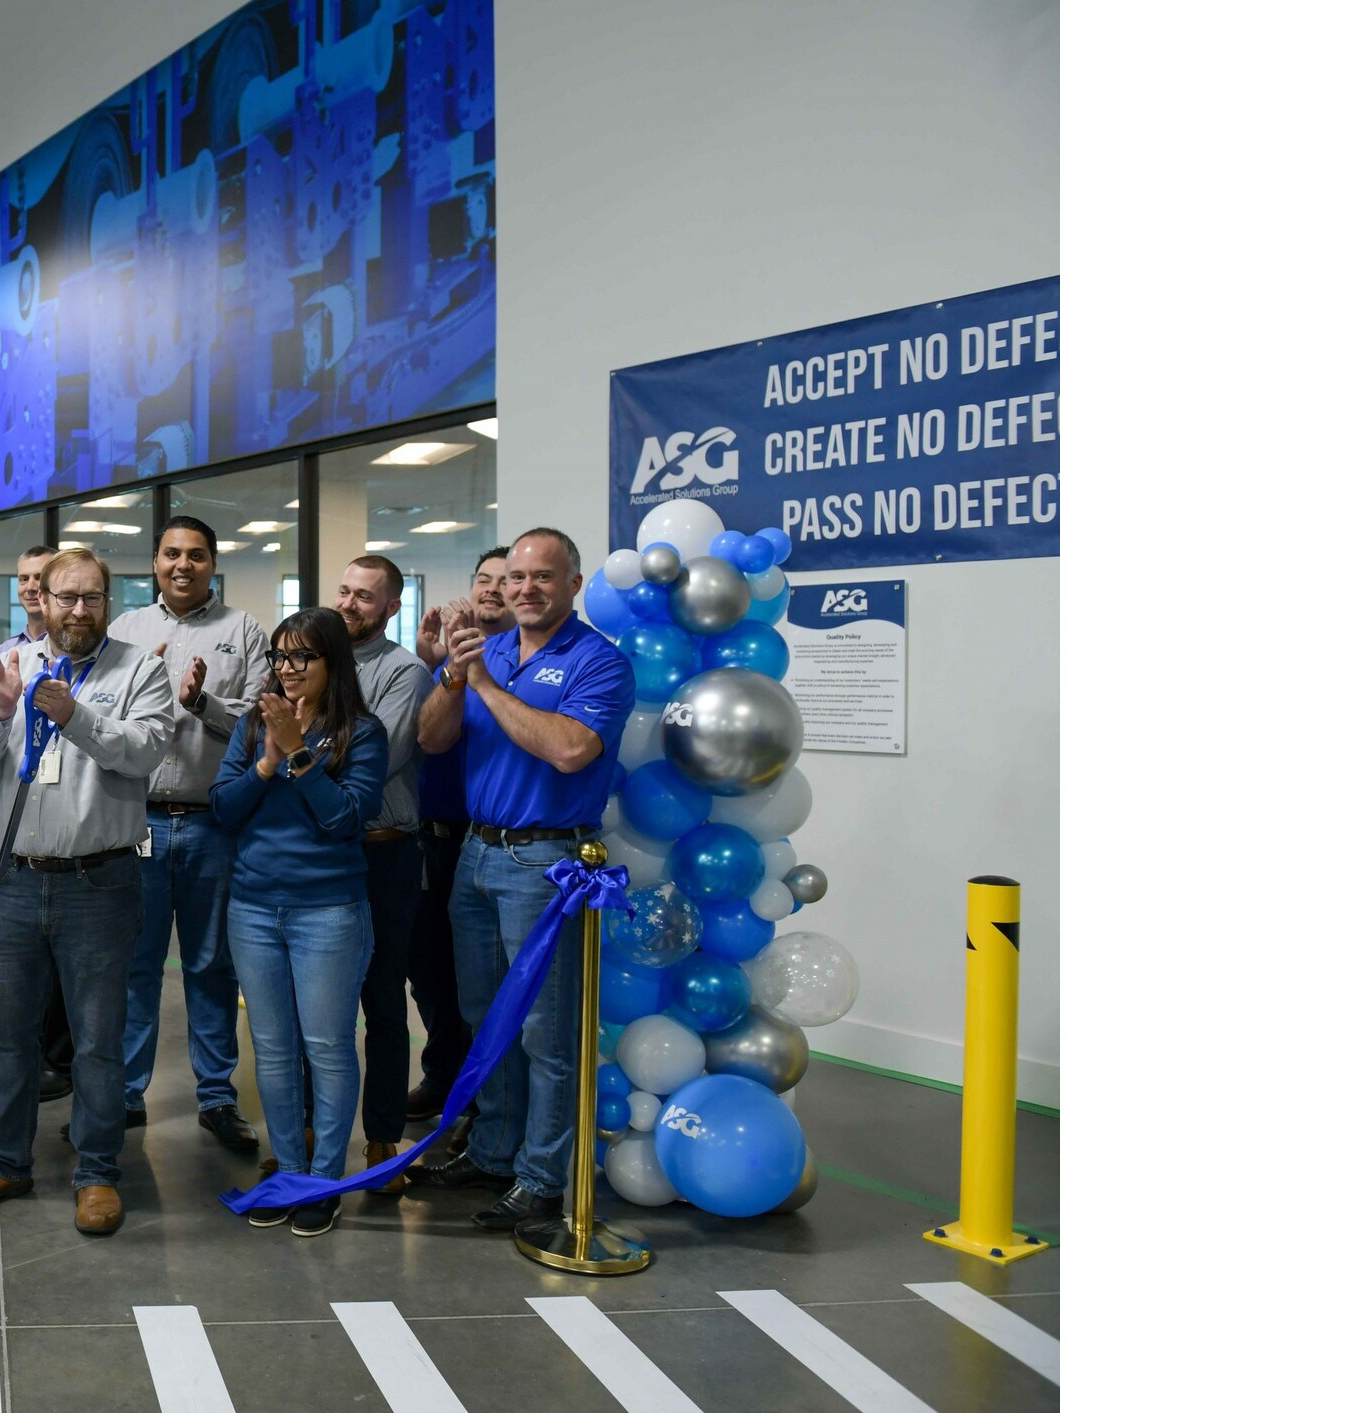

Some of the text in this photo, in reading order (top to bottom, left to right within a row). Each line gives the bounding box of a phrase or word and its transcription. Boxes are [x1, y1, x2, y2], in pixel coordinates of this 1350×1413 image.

[764, 311, 1058, 408] ACCEPT NO DEFE
[764, 391, 1060, 476] CREATE NO DEFE
[630, 426, 740, 495] ASG
[630, 484, 739, 506] Accelerated Solutions Group
[783, 472, 1060, 542] PASS NO DEFEC
[820, 589, 868, 613] ASG
[215, 642, 237, 655] ASG
[845, 633, 861, 641] Policy
[534, 667, 564, 685] ASG
[88, 691, 115, 704] ASG
[33, 717, 43, 747] ASG
[660, 1104, 702, 1140] ASG
